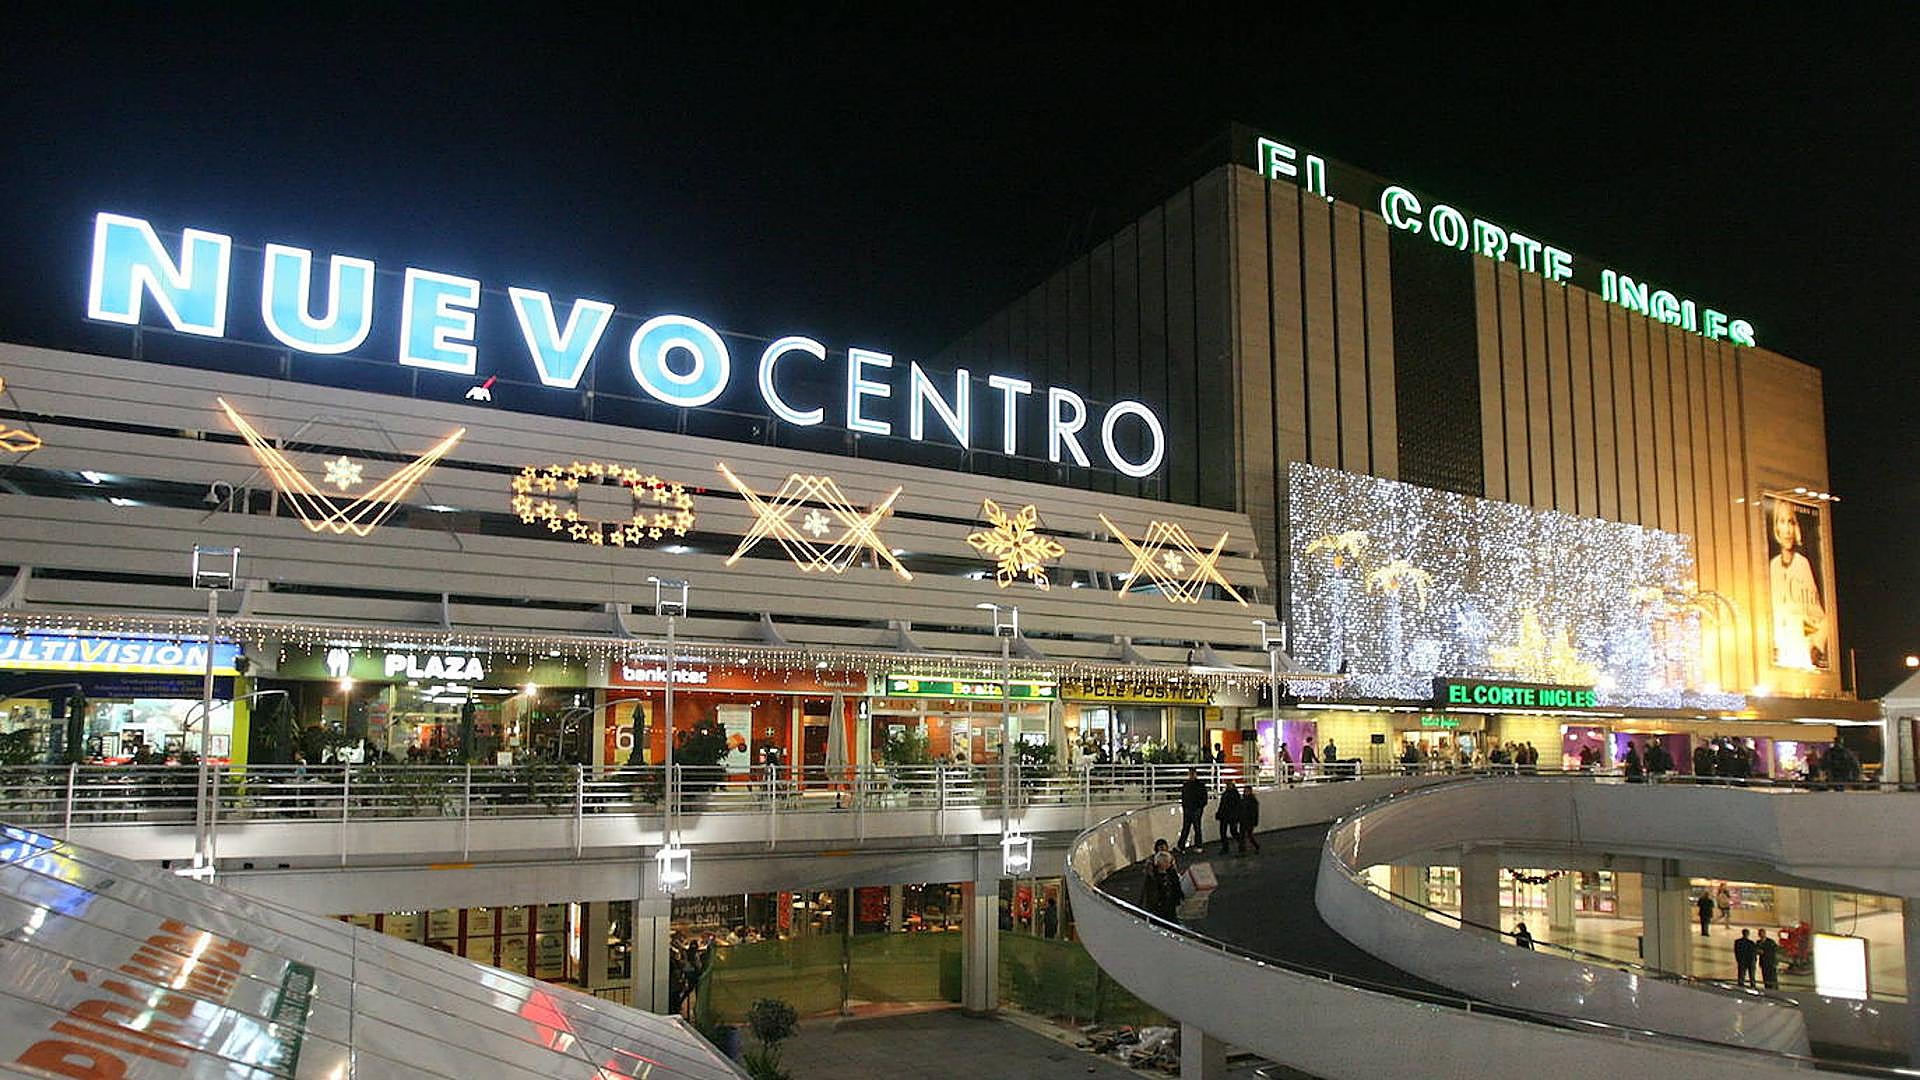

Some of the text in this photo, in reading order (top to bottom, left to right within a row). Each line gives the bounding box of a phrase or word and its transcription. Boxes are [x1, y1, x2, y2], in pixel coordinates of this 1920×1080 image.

[385, 654, 485, 682] PLAZA
[1449, 684, 1598, 708] EL CORTE INGLES
